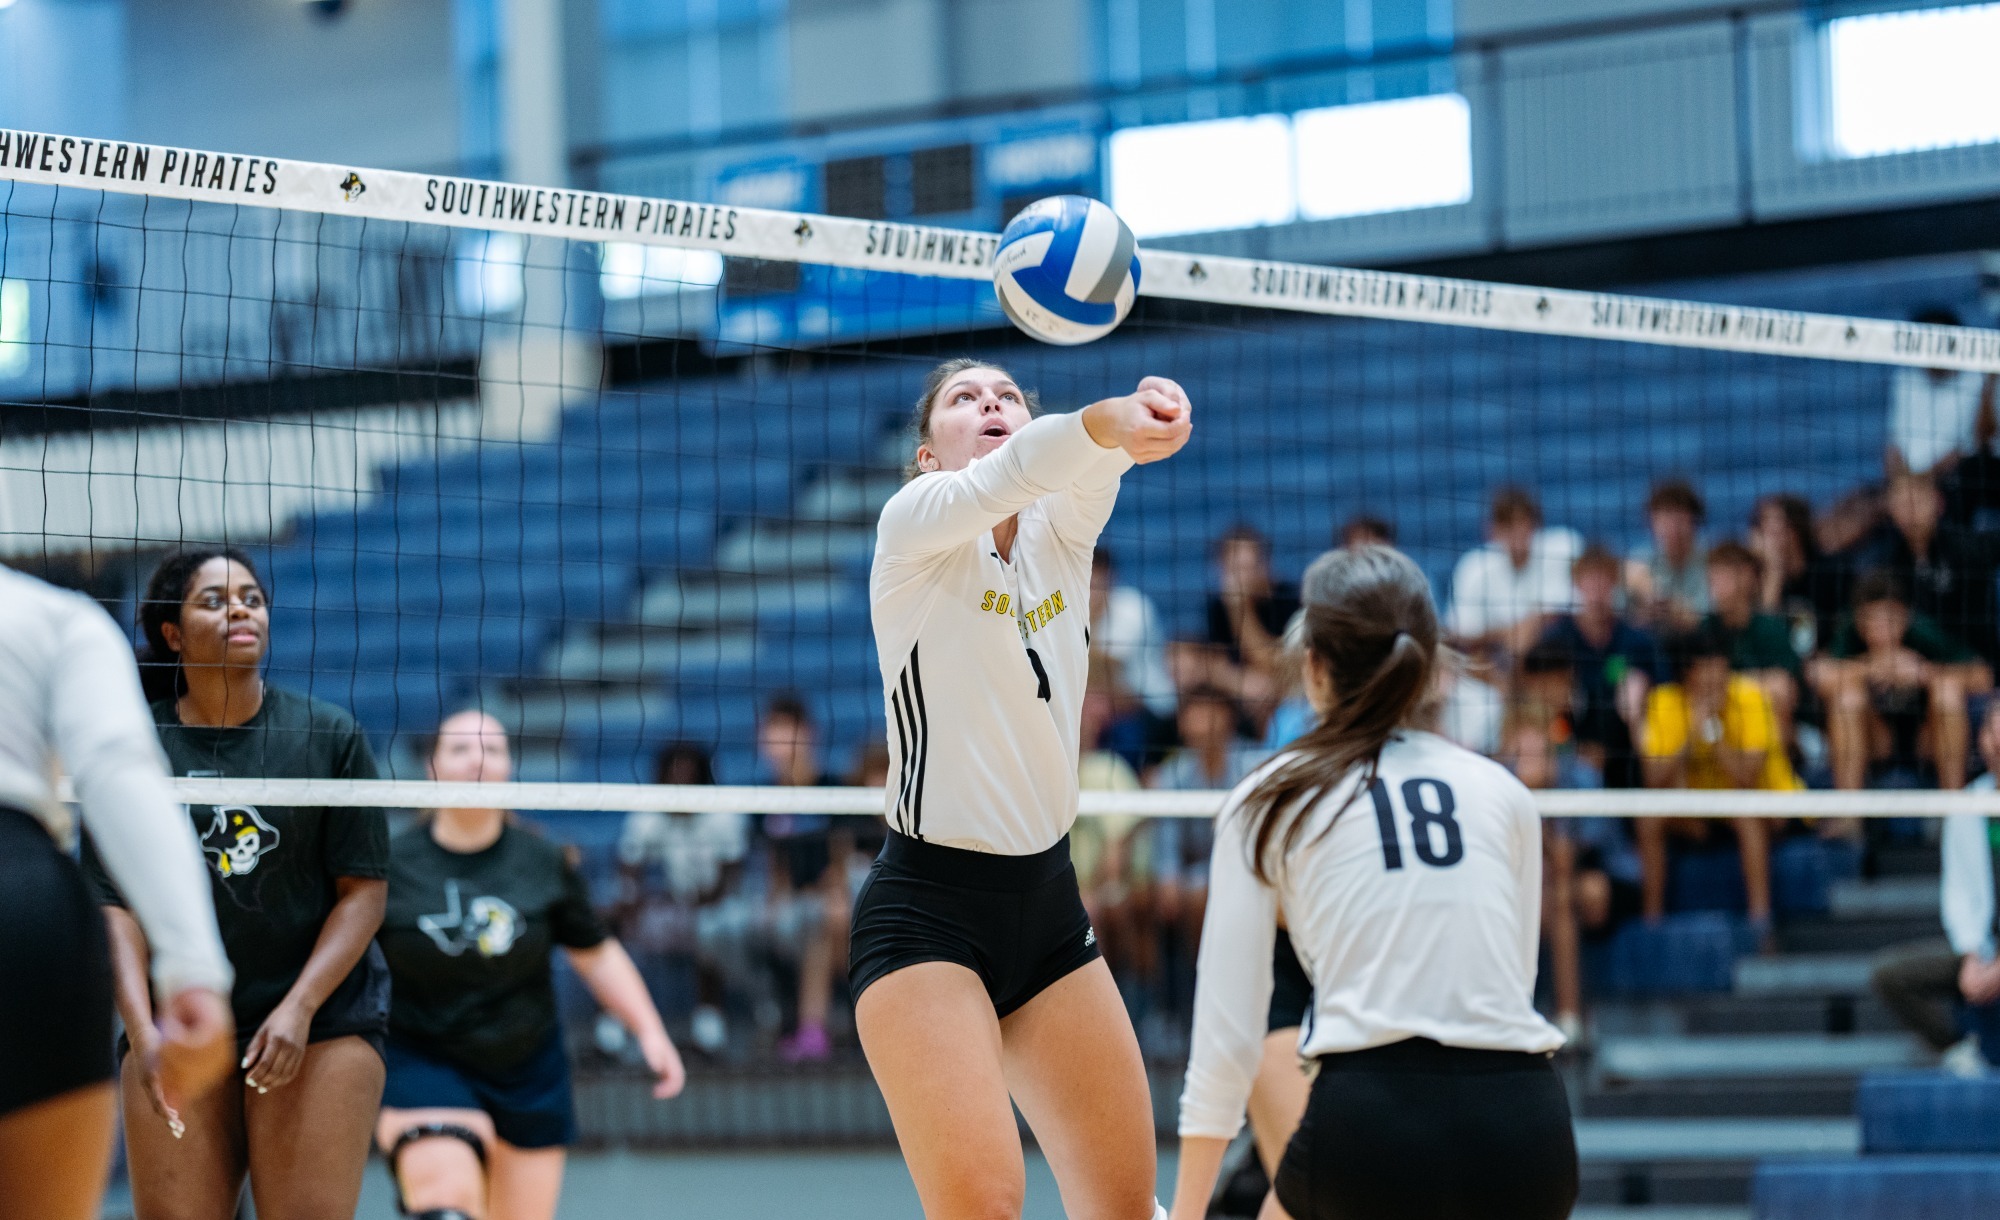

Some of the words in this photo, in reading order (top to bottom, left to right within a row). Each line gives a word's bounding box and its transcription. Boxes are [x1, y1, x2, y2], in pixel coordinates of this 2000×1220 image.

[160, 149, 279, 194] PIRATES
[425, 179, 627, 231] SOUTHWESTERN
[635, 201, 739, 240] PIRATES
[1368, 777, 1464, 870] 18
